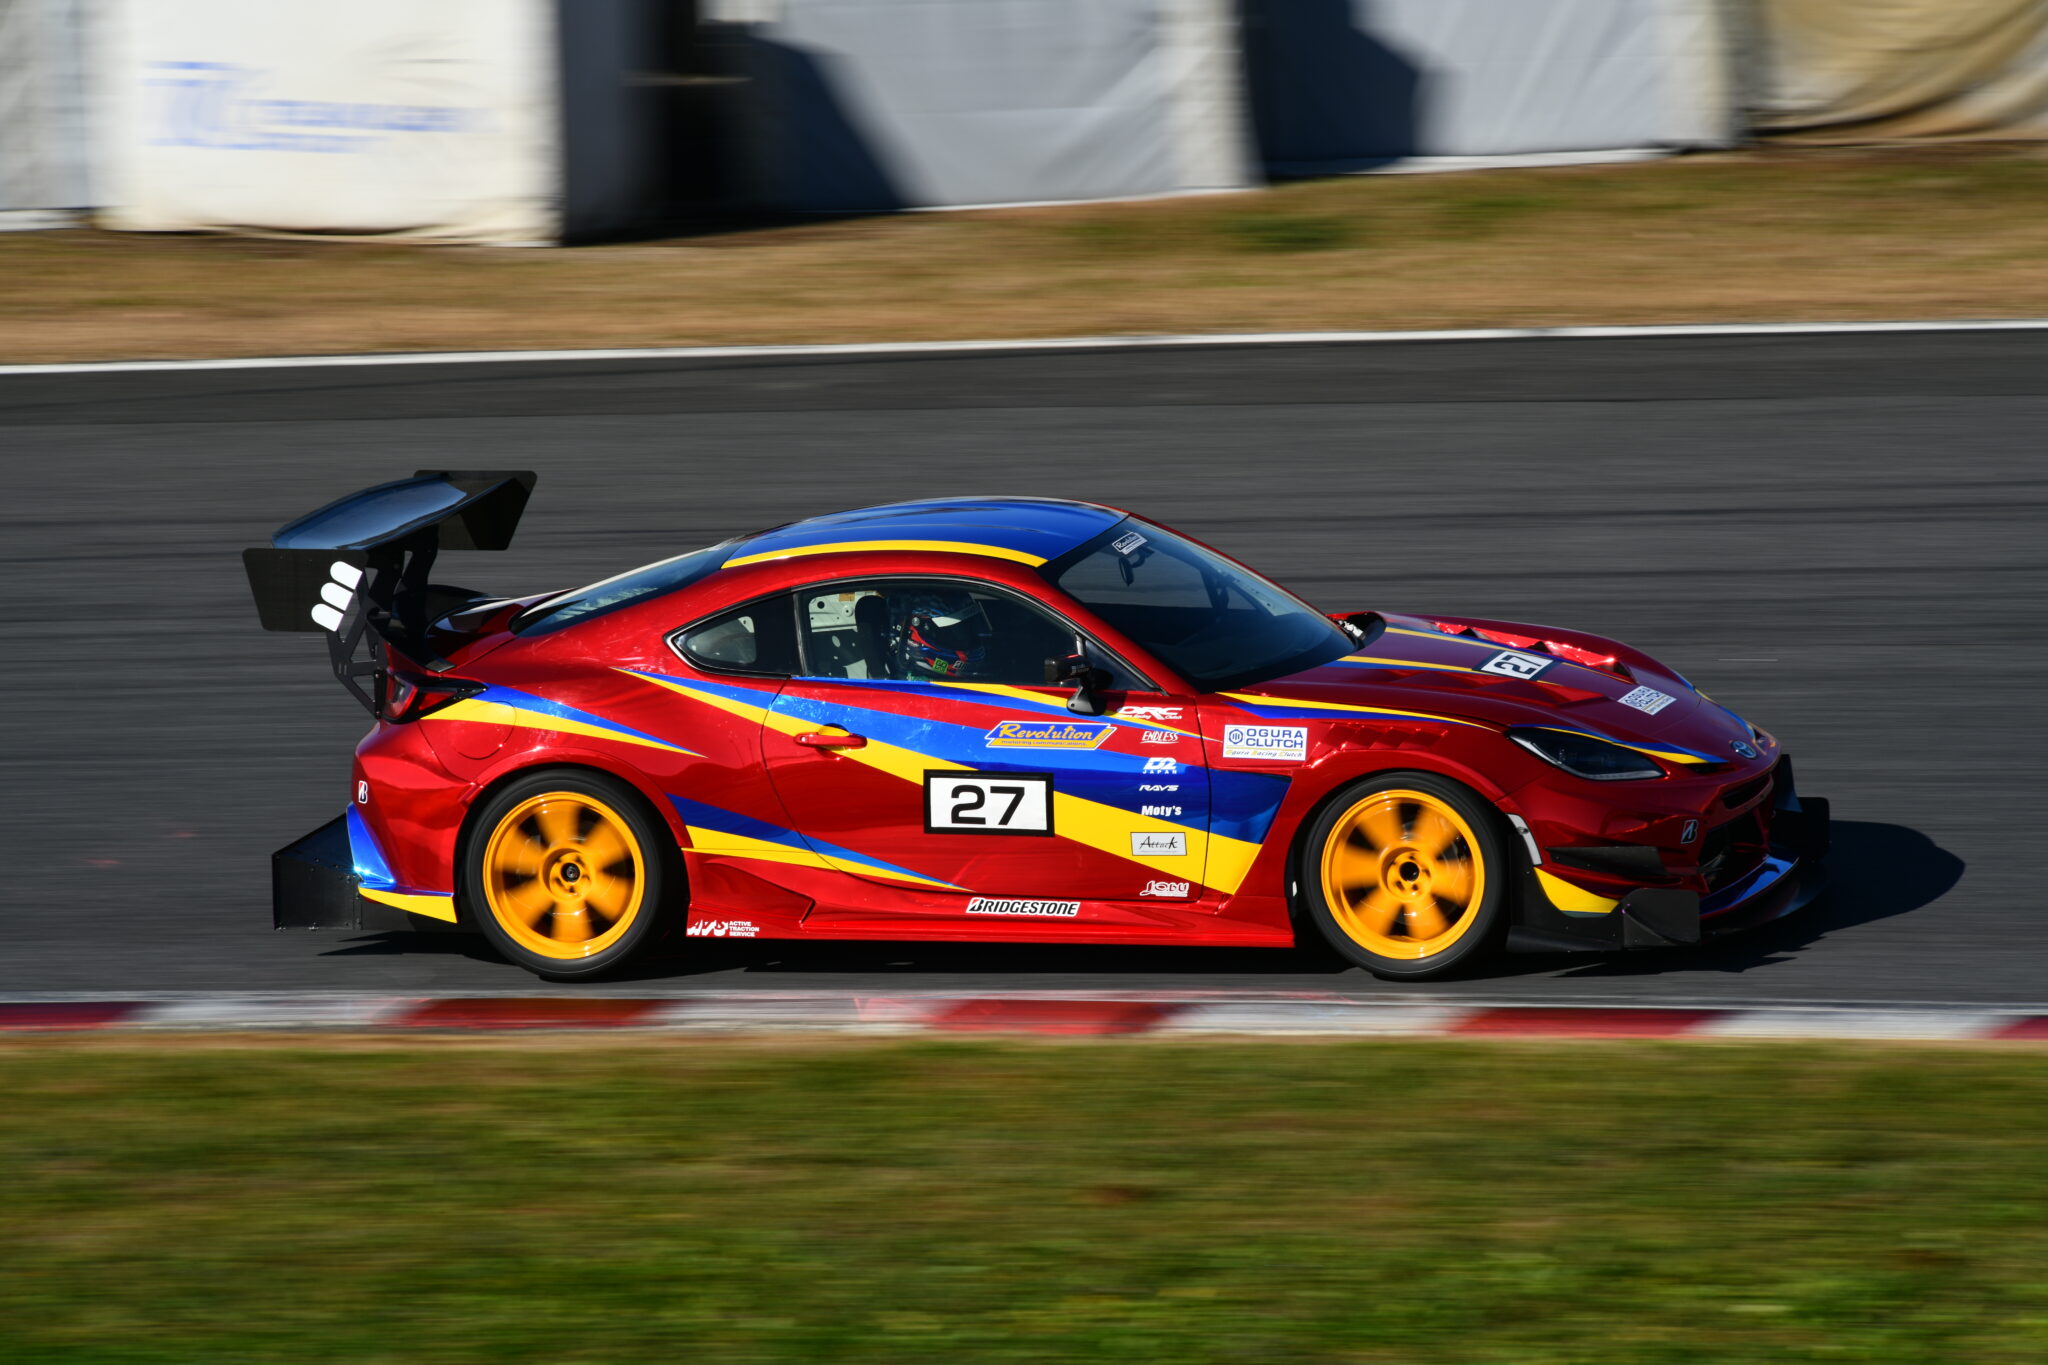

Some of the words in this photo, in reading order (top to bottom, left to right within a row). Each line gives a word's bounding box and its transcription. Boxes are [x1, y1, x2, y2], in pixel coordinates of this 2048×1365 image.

[1493, 654, 1542, 675] 27
[999, 723, 1092, 740] Revolution
[1141, 731, 1178, 741] ENDLESS
[1246, 728, 1304, 739] OGURA
[1246, 738, 1304, 748] CLUTCH
[951, 784, 1025, 825] 27
[1141, 805, 1182, 817] Moty's
[1139, 836, 1178, 850] Attack
[968, 898, 1079, 915] BRIDGESTONE
